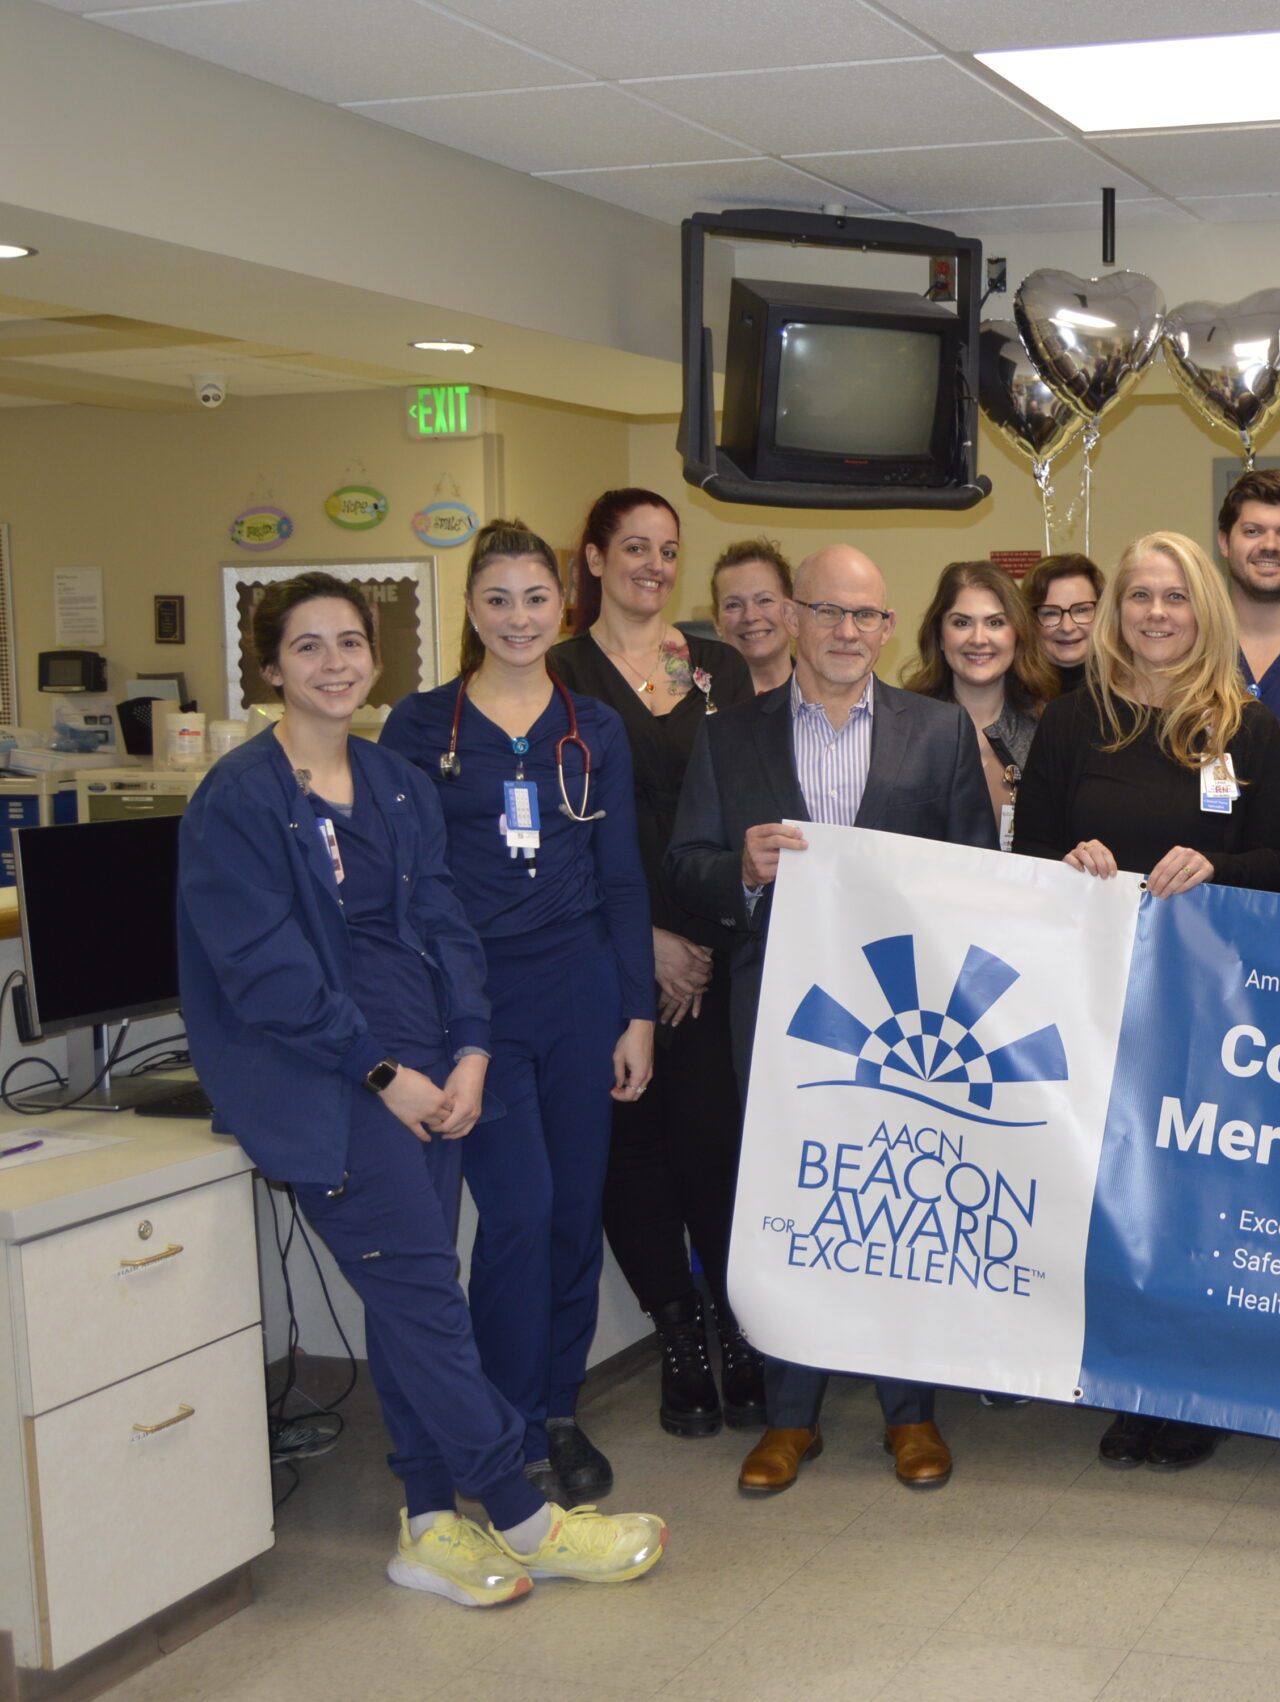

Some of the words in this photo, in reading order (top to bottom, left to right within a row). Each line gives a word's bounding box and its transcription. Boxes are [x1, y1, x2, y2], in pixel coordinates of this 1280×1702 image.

[418, 386, 470, 433] EXIT
[868, 1120, 964, 1163] AACN
[797, 1139, 1037, 1227] BEACON
[762, 1215, 796, 1234] FOR
[787, 1233, 1031, 1298] EXCELLENCE
[810, 1190, 1019, 1263] AWARD
